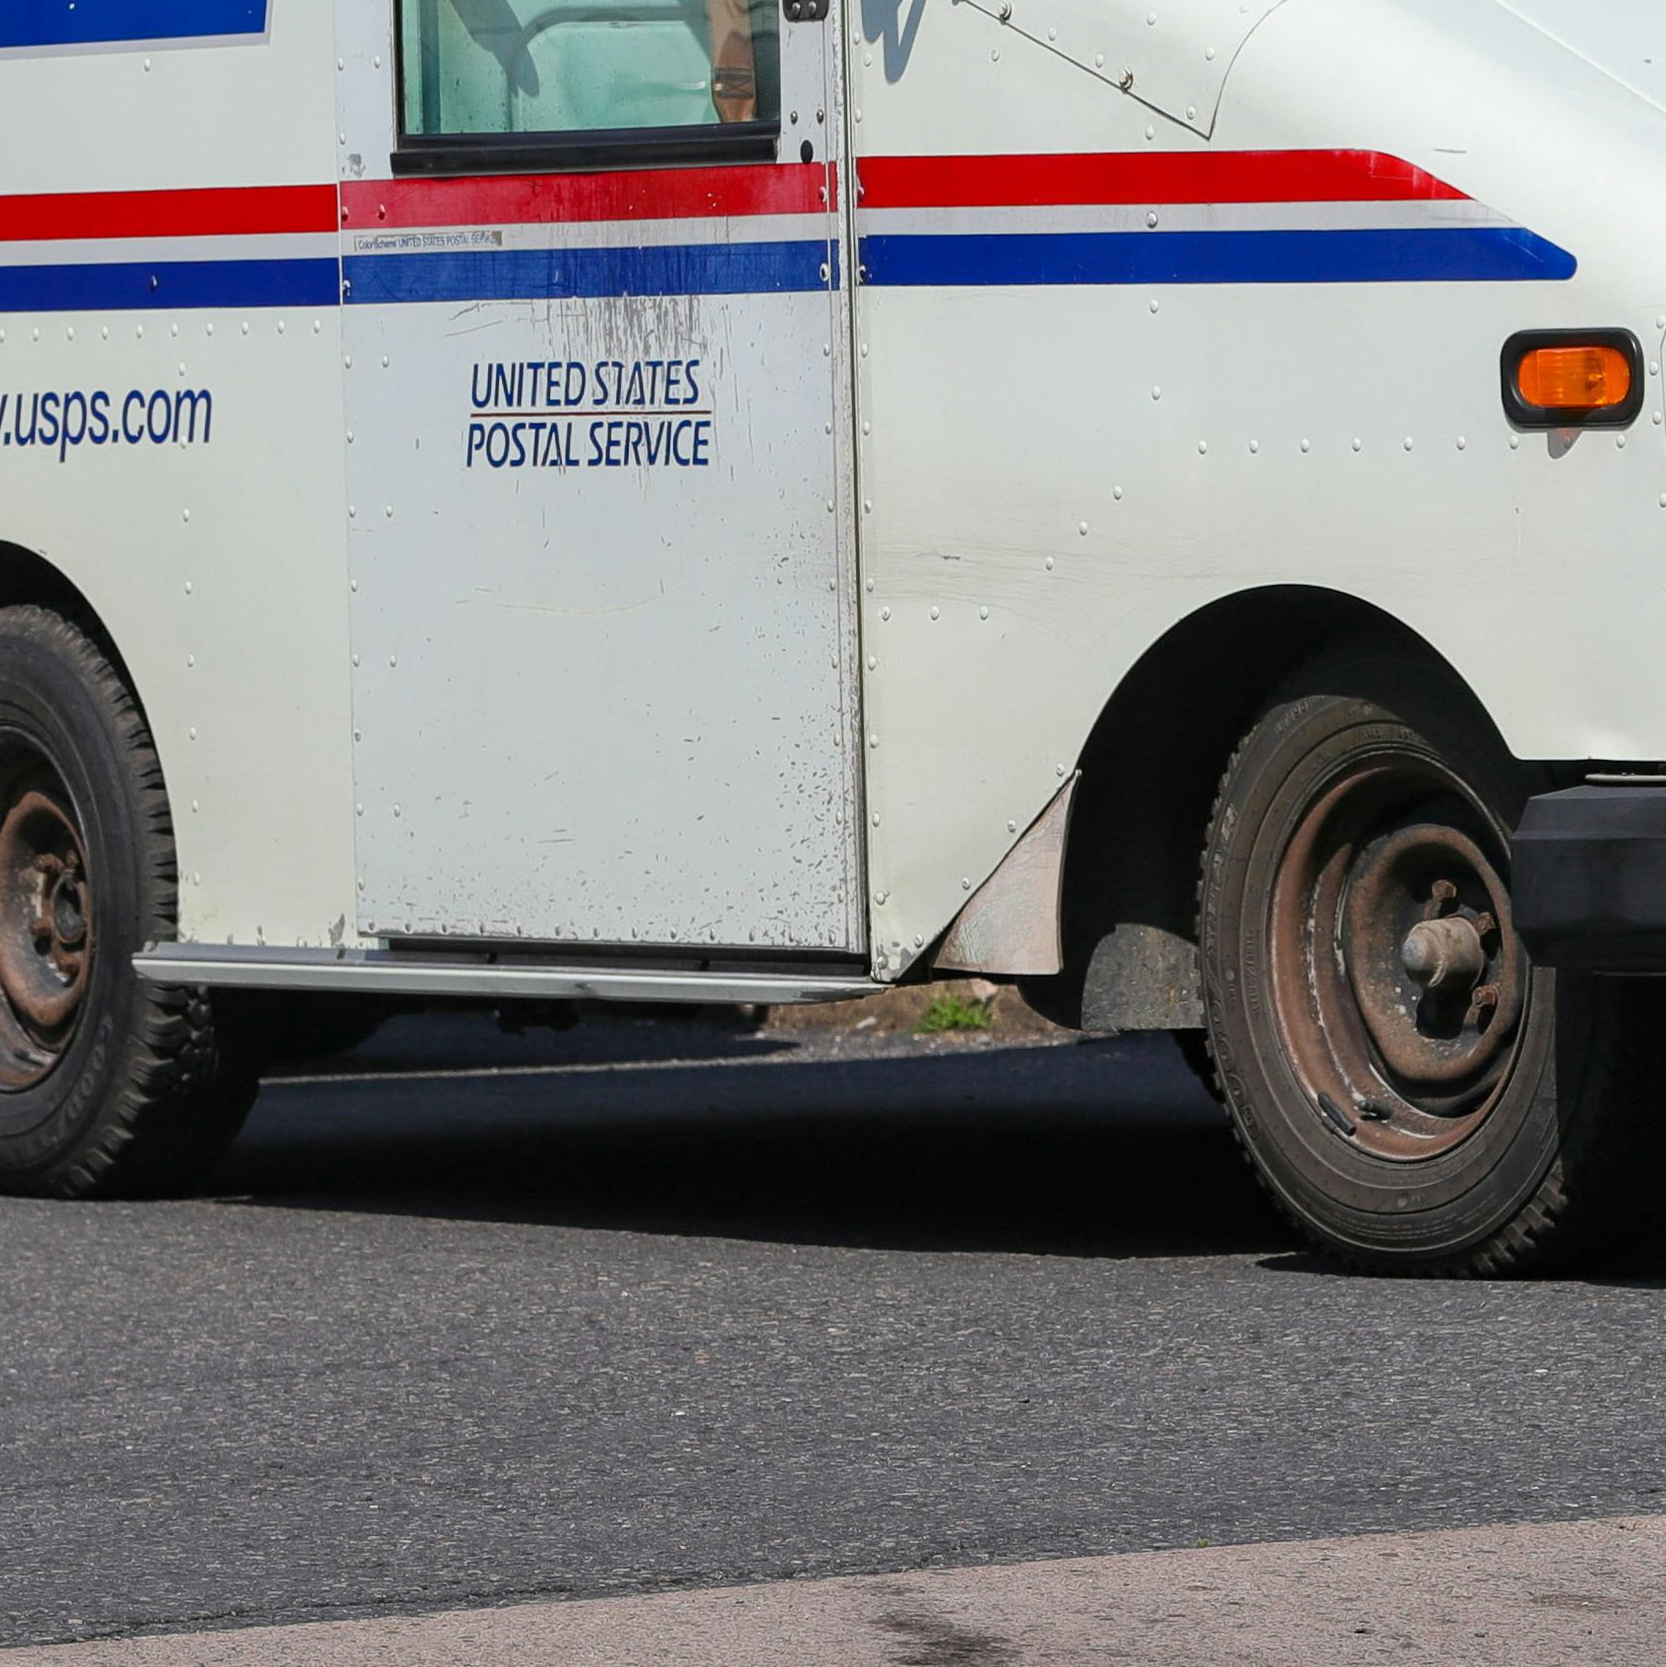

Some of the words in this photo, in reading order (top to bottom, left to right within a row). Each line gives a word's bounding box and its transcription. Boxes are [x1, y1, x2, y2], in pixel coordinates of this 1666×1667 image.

[398, 235, 422, 248] UNITED
[423, 234, 445, 247] STATES
[471, 361, 586, 408] UNITED
[593, 359, 700, 406] STATES
[466, 421, 580, 469] POSTAL
[587, 419, 712, 467] SERVICE
